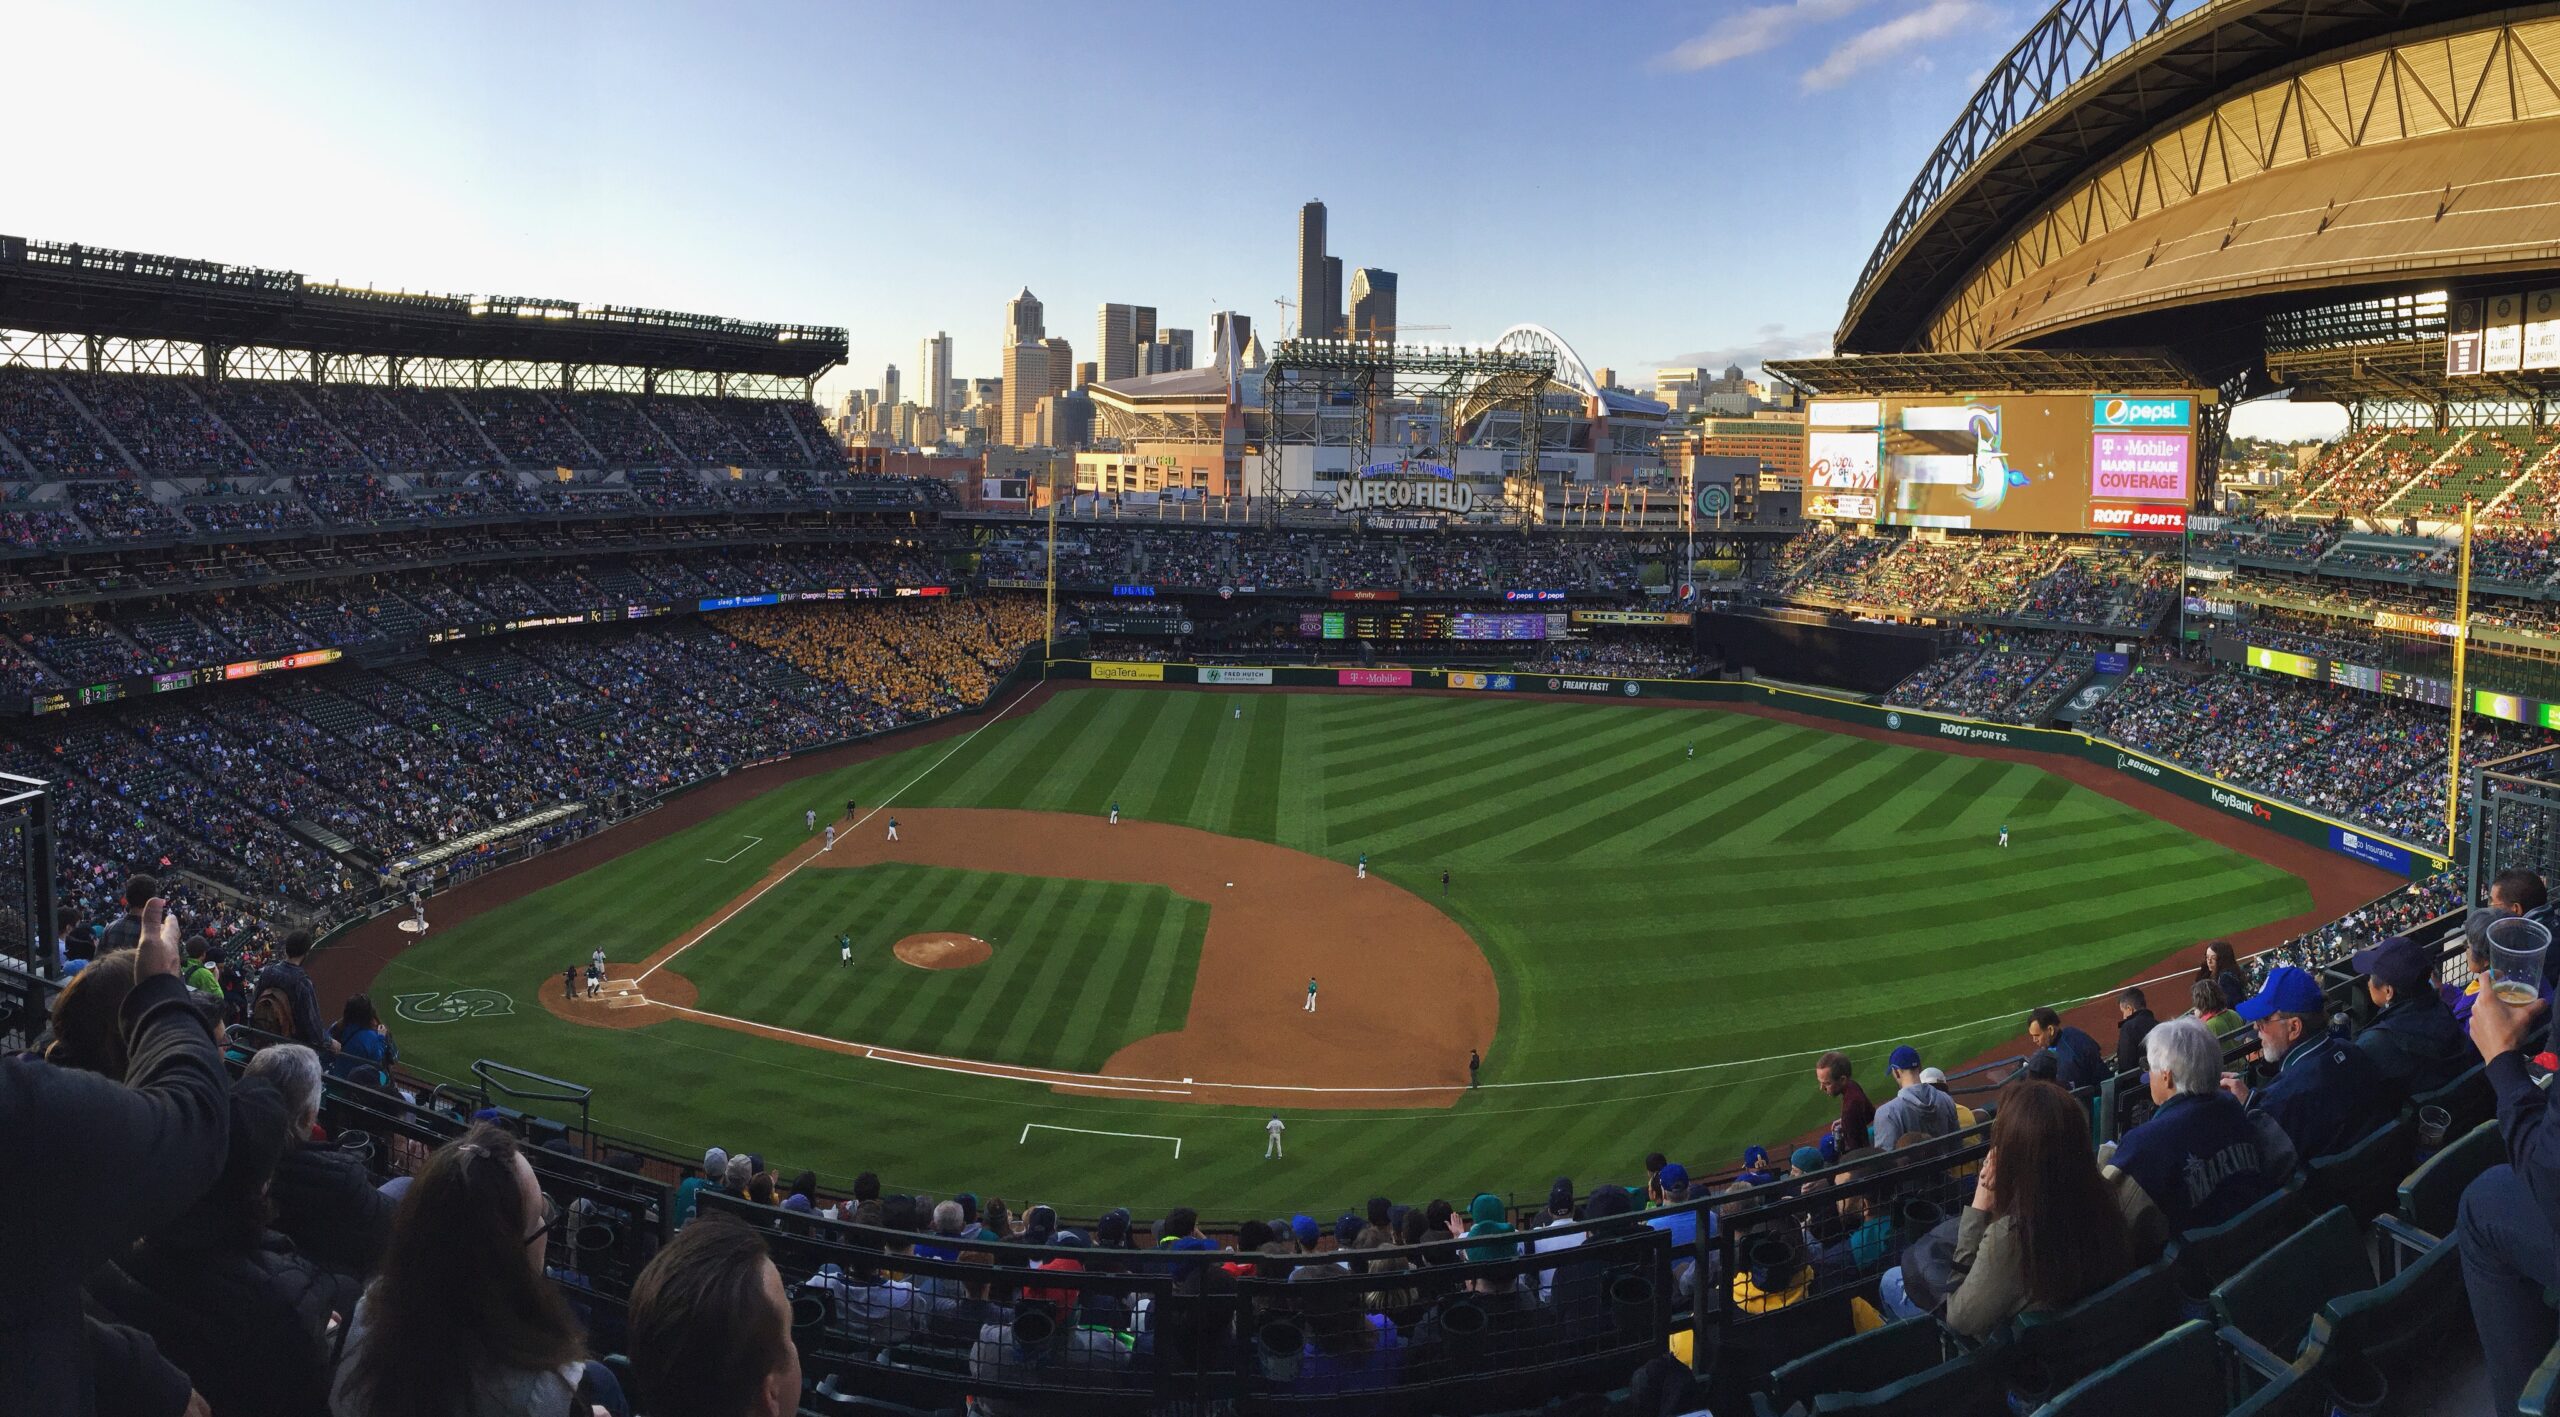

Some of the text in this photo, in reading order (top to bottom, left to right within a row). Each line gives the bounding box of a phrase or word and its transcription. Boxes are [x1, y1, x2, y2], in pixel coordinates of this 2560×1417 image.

[2500, 338, 2515, 349] WEST
[2540, 335, 2555, 346] WEST
[2487, 355, 2517, 366] CHAMPIONS
[2526, 351, 2558, 363] CHAMPIONS
[2130, 402, 2177, 422] pepsi
[1417, 461, 1455, 481] MARINERS
[2101, 460, 2178, 473] MAJOR LEAGUE
[2100, 473, 2178, 489] COVERAGE
[1337, 479, 1473, 515] SAFECO FIELD
[2093, 509, 2133, 523] ROOT
[1376, 516, 1439, 529] TRUE TO THE BLUE
[997, 580, 1046, 588] KING'S COURT
[801, 592, 826, 600] Changeup
[895, 588, 911, 597] 710
[1354, 591, 1376, 599] xfinity
[2217, 602, 2234, 615] DAYS
[521, 619, 543, 628] Locations
[543, 618, 556, 627] Open
[568, 615, 584, 623] Round
[1580, 613, 1618, 621] THE
[429, 633, 443, 643] 7:36
[228, 667, 245, 676] HOME
[245, 664, 258, 672] RUN
[258, 659, 287, 671] COVERAGE
[296, 650, 342, 665] SEATTLETIMES.COM
[205, 674, 210, 682] 2
[217, 671, 222, 680] 2
[1094, 666, 1137, 678] GigaTera
[161, 682, 174, 691] 261
[1562, 680, 1610, 691] FREAKY FAST!
[42, 702, 70, 712] Mariners
[1940, 723, 1970, 737] ROOT
[2127, 758, 2161, 777] BOEING
[2211, 787, 2254, 815] KeyBank
[2365, 842, 2394, 860] Insurance
[2431, 859, 2443, 870] 326
